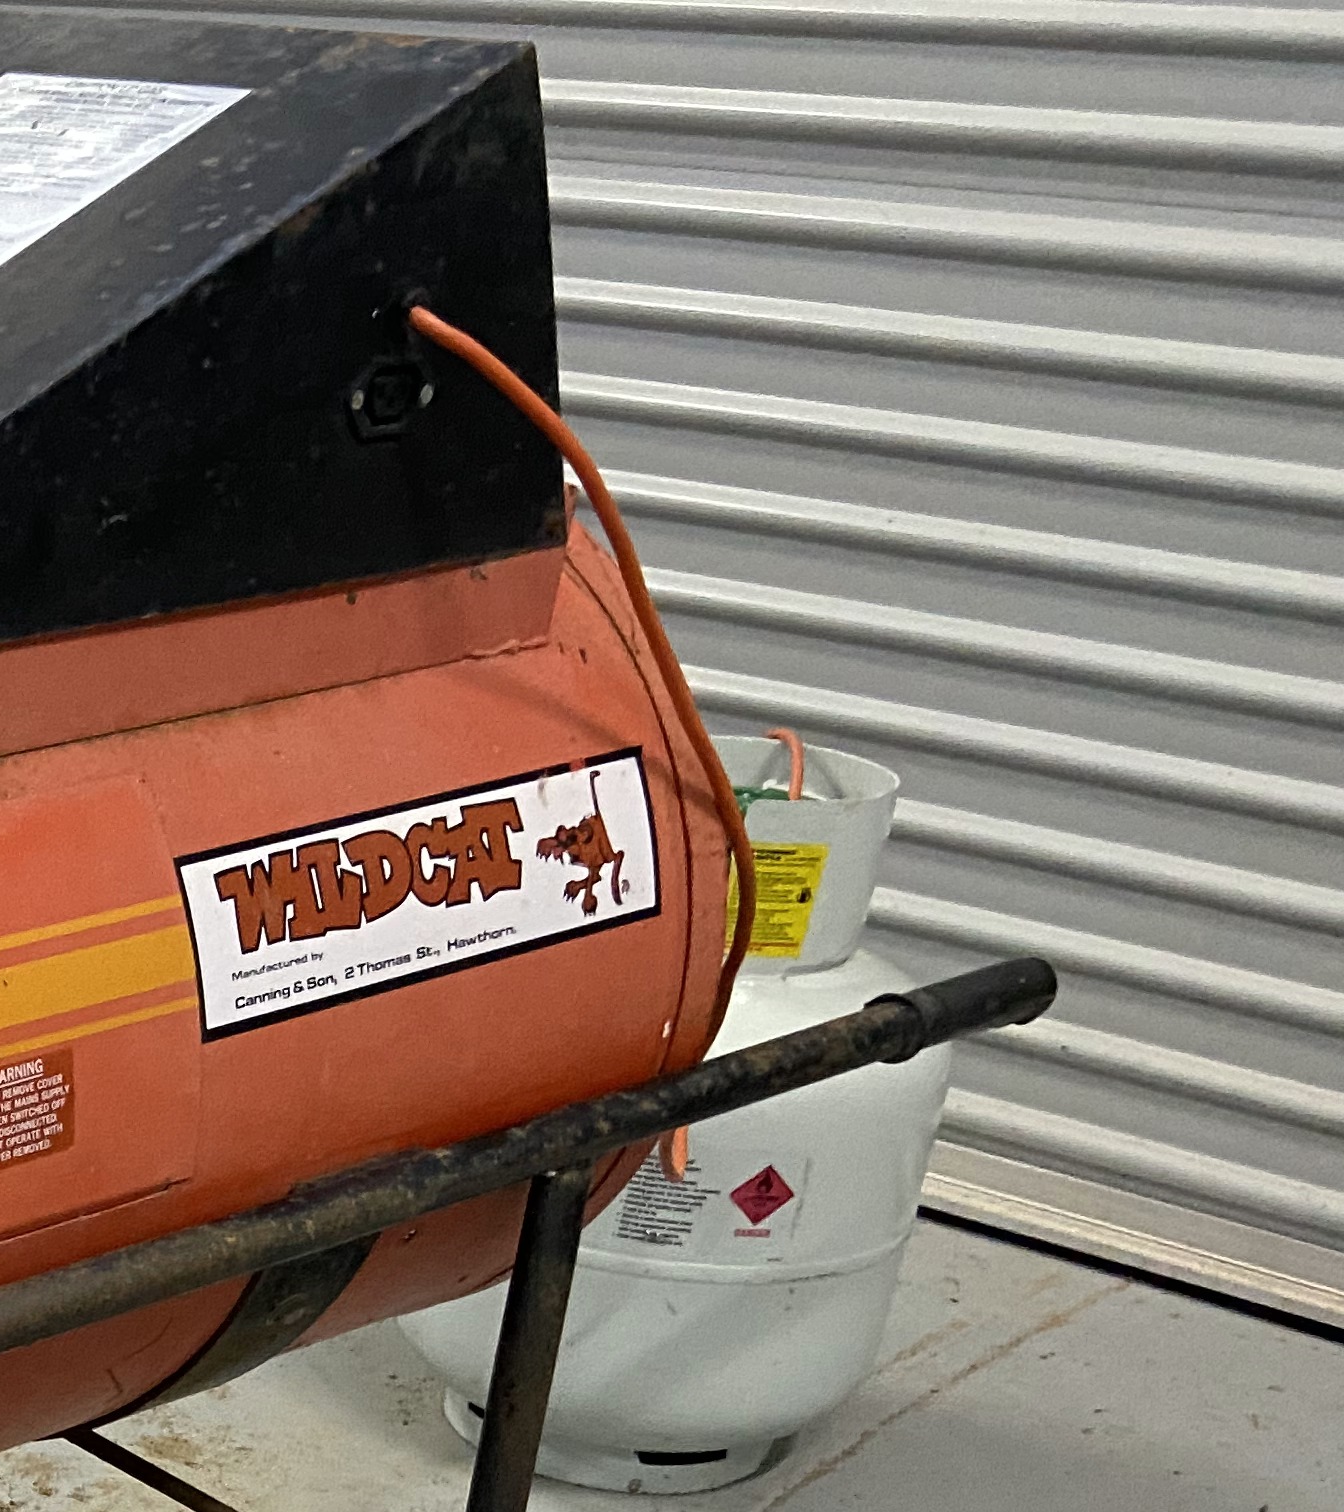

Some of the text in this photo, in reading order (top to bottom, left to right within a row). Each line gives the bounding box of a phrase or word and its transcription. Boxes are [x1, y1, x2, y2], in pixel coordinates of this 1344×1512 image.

[214, 797, 524, 954] WILDCAT
[231, 950, 324, 982] Manufactured by
[235, 985, 291, 1010] Canning
[293, 980, 305, 994] &
[306, 974, 338, 990] Son,
[344, 966, 355, 980] 2
[356, 953, 412, 976] Thomas
[2, 1081, 35, 1100] REMOVE
[37, 1073, 64, 1090] COVER
[14, 1092, 39, 1108] MAINS
[41, 1084, 70, 1101] SUPPLY
[10, 1103, 50, 1122] SWITCHED
[51, 1097, 66, 1111] OFF
[5, 1128, 42, 1148] OPERATE
[43, 1122, 64, 1136] WITH
